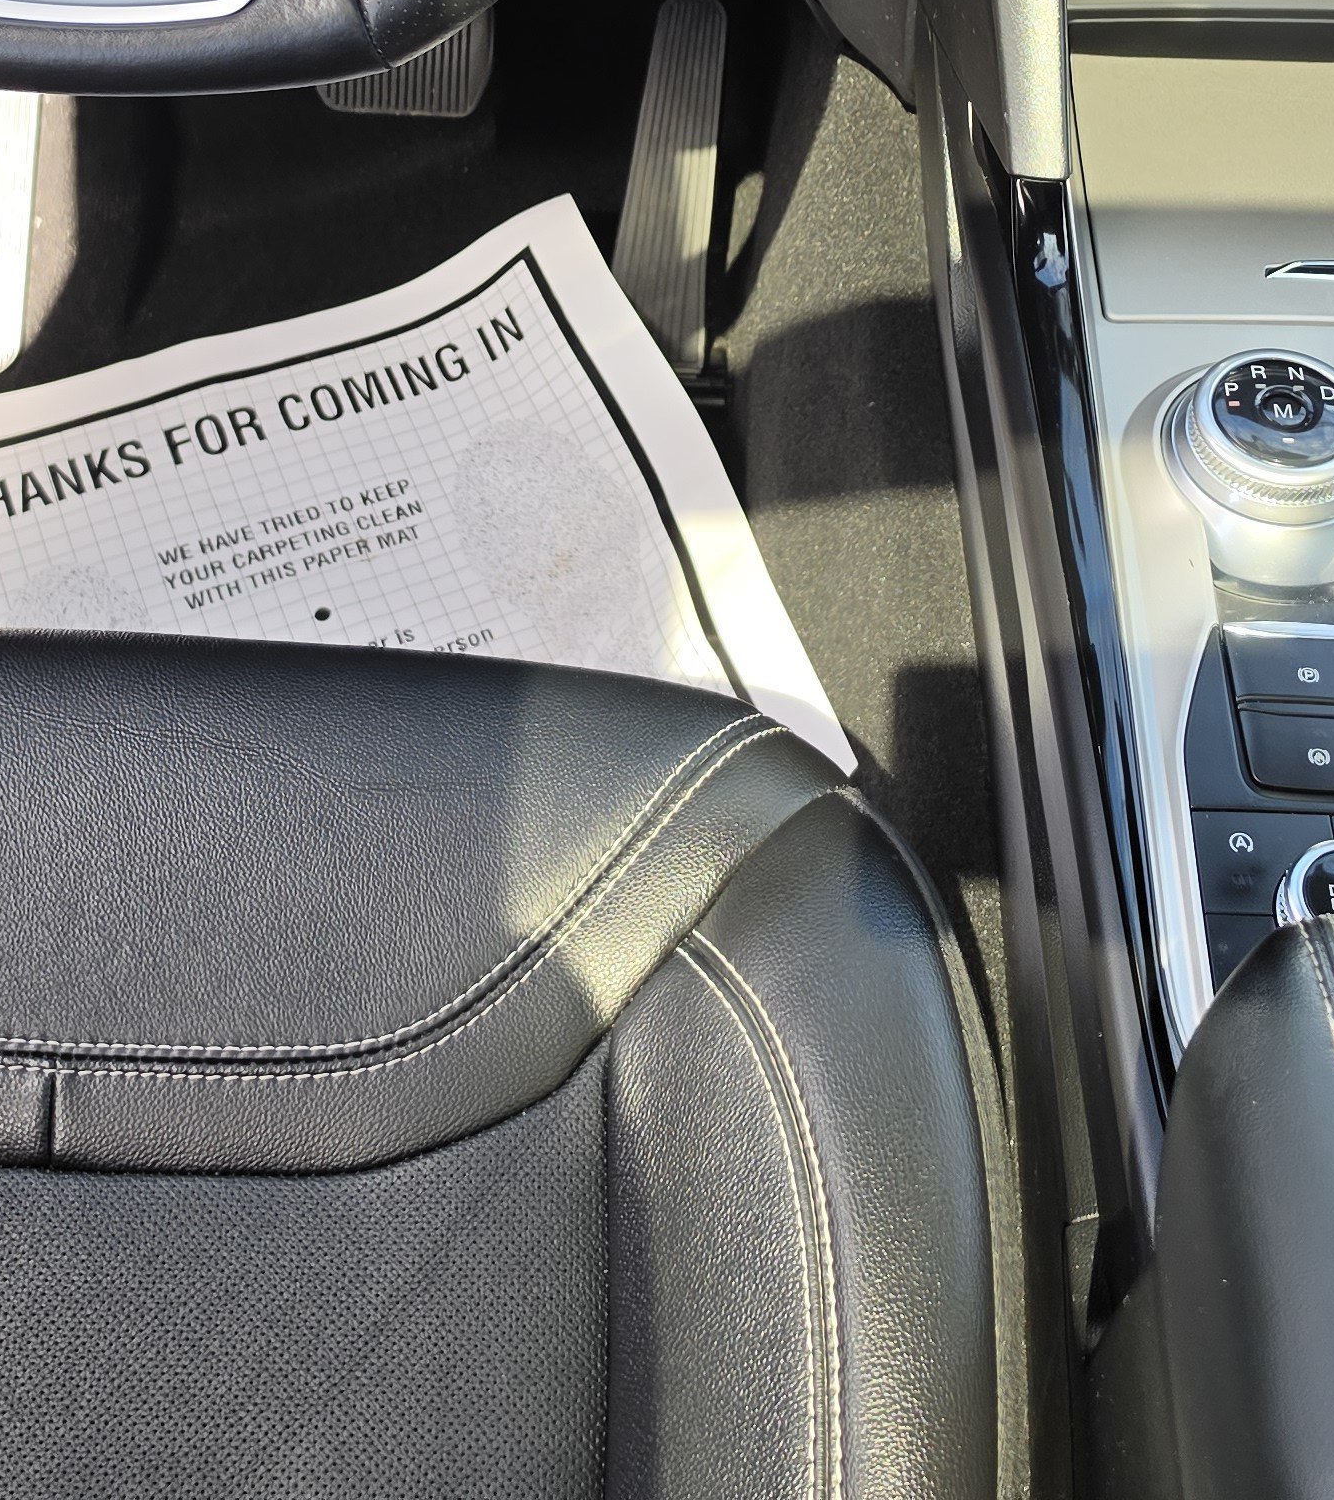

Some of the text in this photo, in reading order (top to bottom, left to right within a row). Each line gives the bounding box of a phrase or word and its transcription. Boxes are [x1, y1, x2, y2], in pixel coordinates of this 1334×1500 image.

[1250, 365, 1267, 379] R
[1288, 366, 1304, 381] N
[163, 405, 267, 467] FOR
[278, 341, 469, 433] COMING
[477, 307, 525, 362] IN
[1224, 382, 1239, 397] P
[1273, 403, 1294, 419] M
[158, 479, 410, 566] WE HAVE TRIED TO KEEP
[164, 500, 423, 590] YOUR CARPETING CLEAN
[184, 524, 420, 610] WITH THIS PAPER MAT
[394, 628, 416, 646] is
